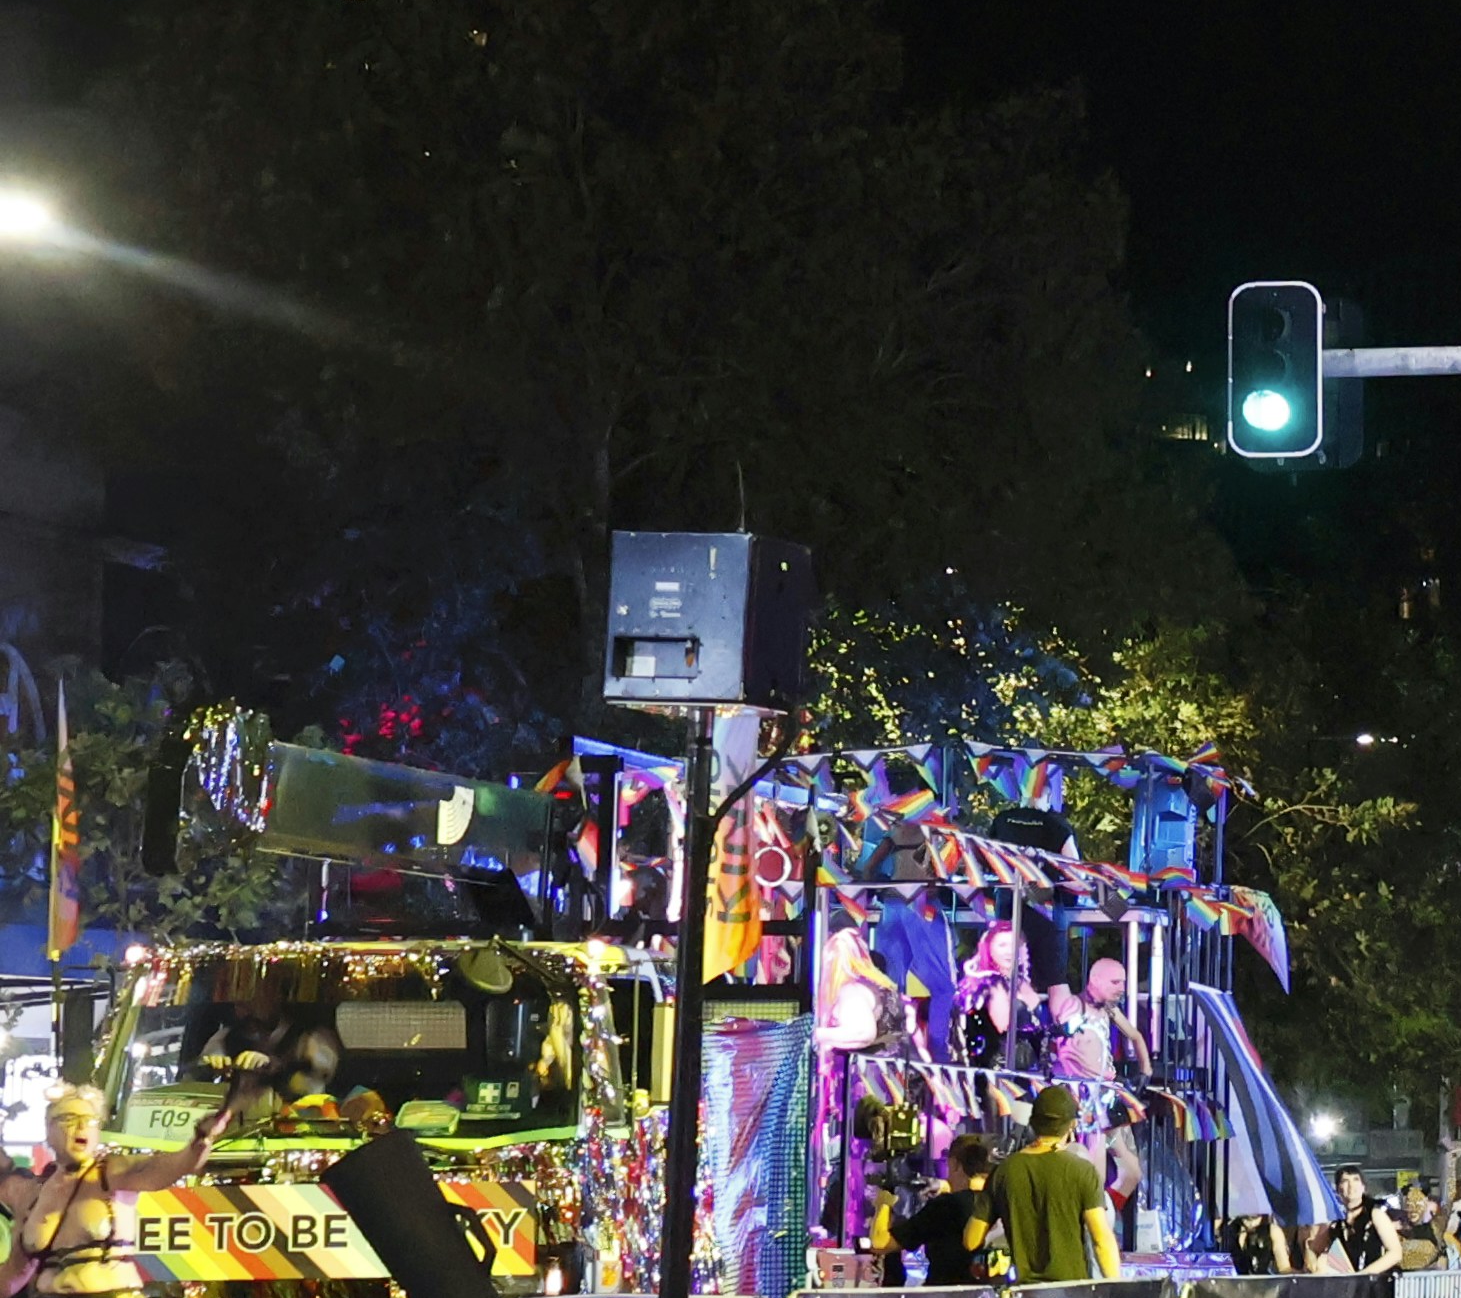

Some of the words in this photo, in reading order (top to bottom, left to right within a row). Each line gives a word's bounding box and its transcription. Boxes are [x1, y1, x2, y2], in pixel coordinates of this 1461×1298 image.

[138, 1216, 192, 1252] EE
[209, 1214, 275, 1253] TO
[291, 1213, 349, 1249] BE
